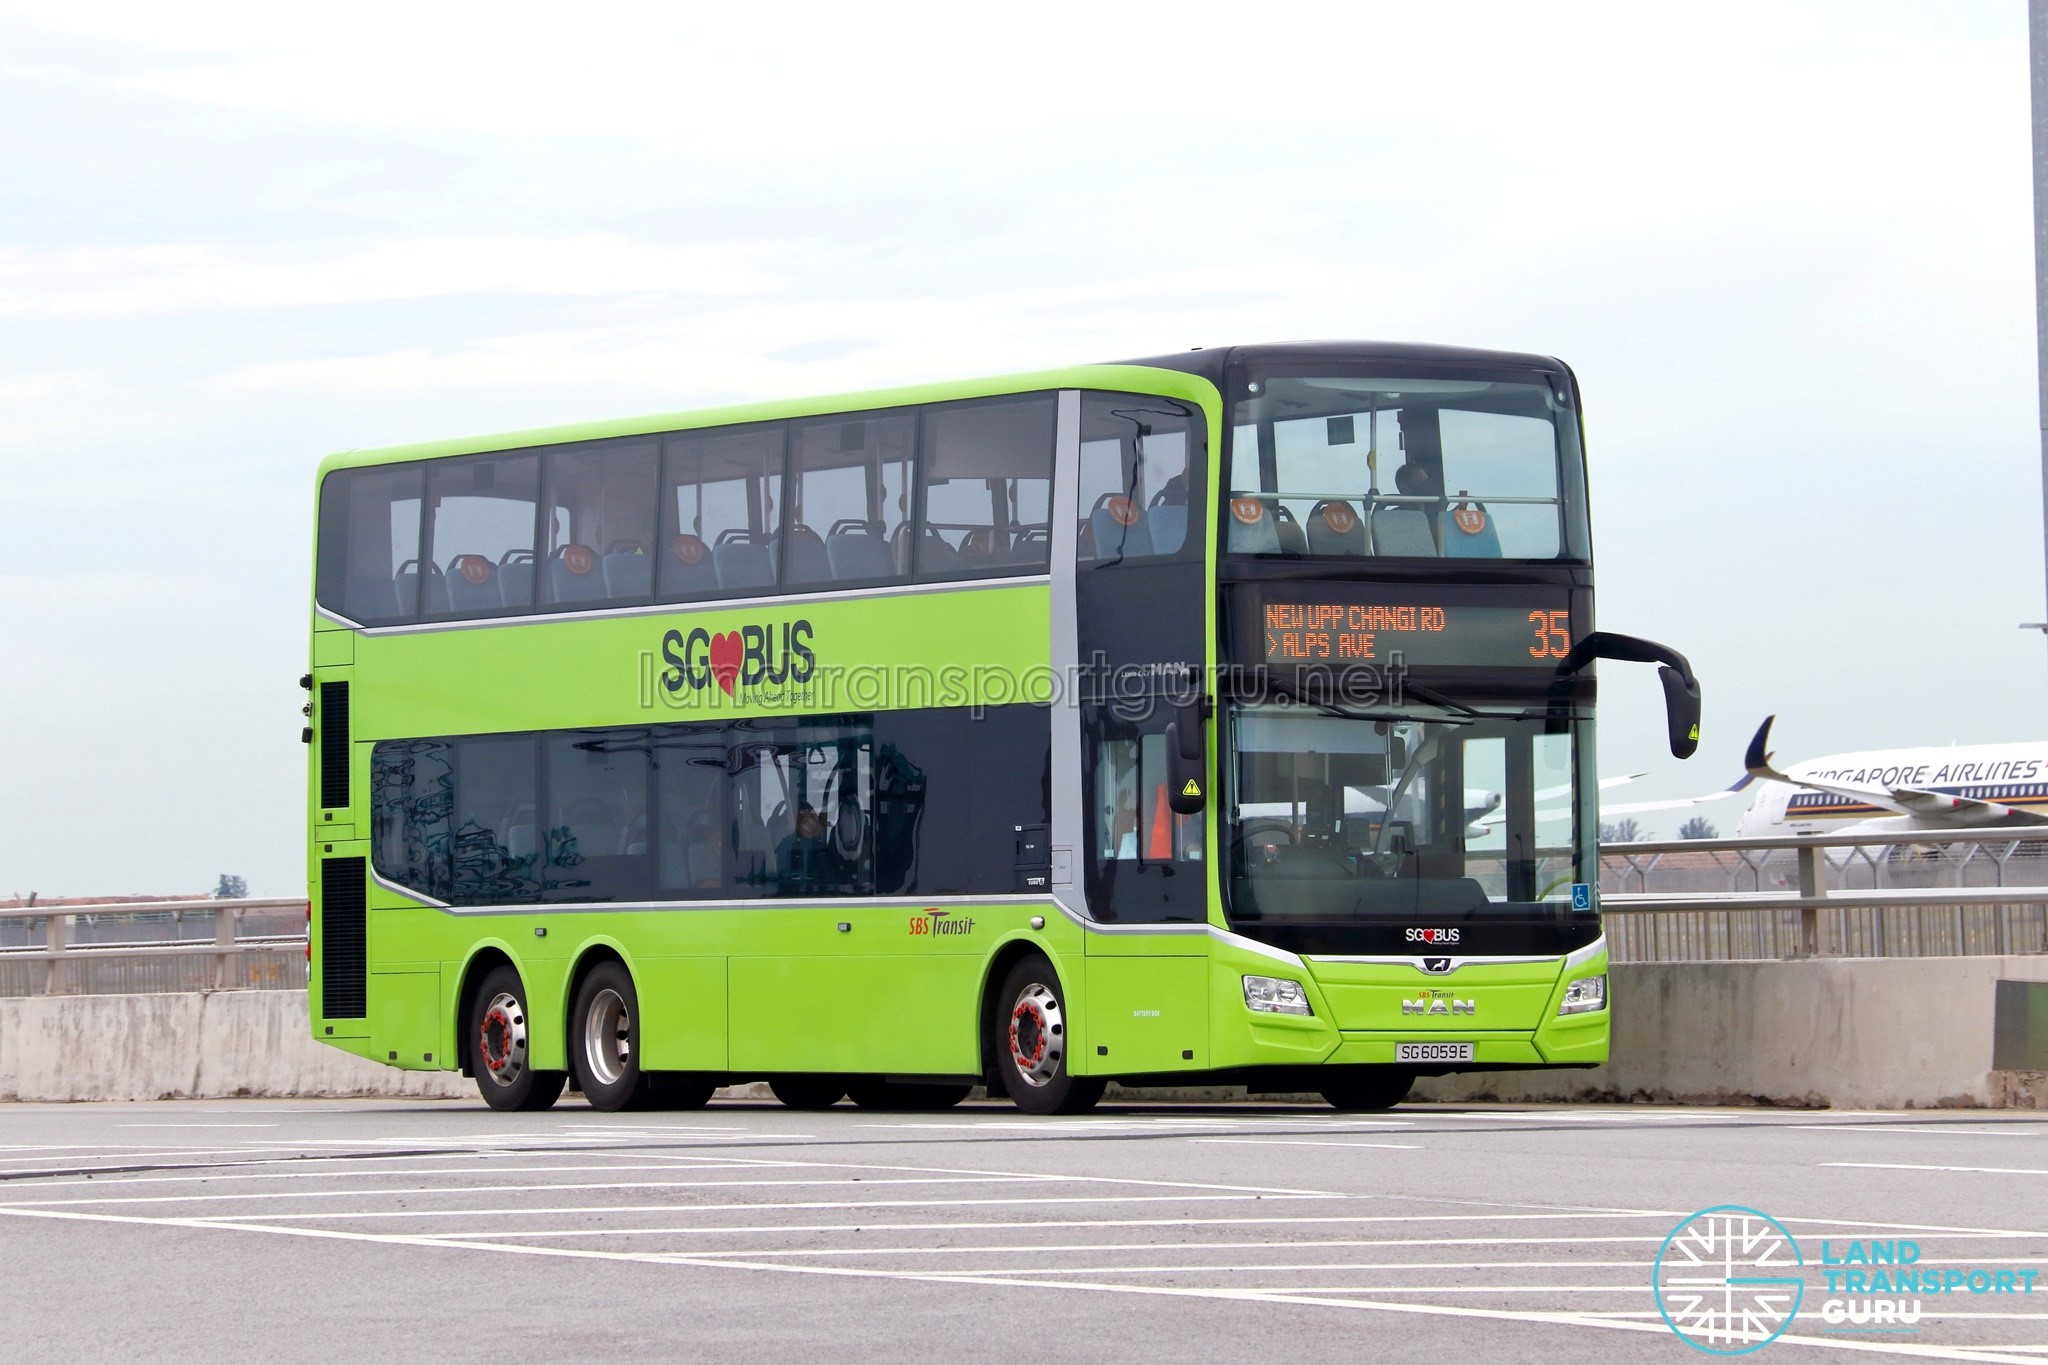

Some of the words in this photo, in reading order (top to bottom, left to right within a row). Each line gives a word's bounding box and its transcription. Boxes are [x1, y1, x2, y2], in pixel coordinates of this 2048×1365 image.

[1266, 604, 1303, 629] NEW
[1307, 605, 1344, 629] UPP
[1349, 605, 1417, 631] CHANGI
[1420, 607, 1446, 631] RD
[1528, 610, 1570, 658] 35
[1282, 632, 1330, 657] ALPS
[1338, 633, 1376, 658] AVE
[1150, 661, 1186, 676] MAN
[738, 692, 764, 707] Moving
[785, 689, 815, 704] Together
[1932, 759, 2043, 783] AIRLINES
[908, 916, 929, 936] SBS
[926, 910, 977, 938] Transit
[1418, 991, 1430, 999] SBS
[1428, 988, 1455, 999] Transit
[1401, 998, 1475, 1016] MAN
[1401, 1045, 1468, 1059] SG6059E
